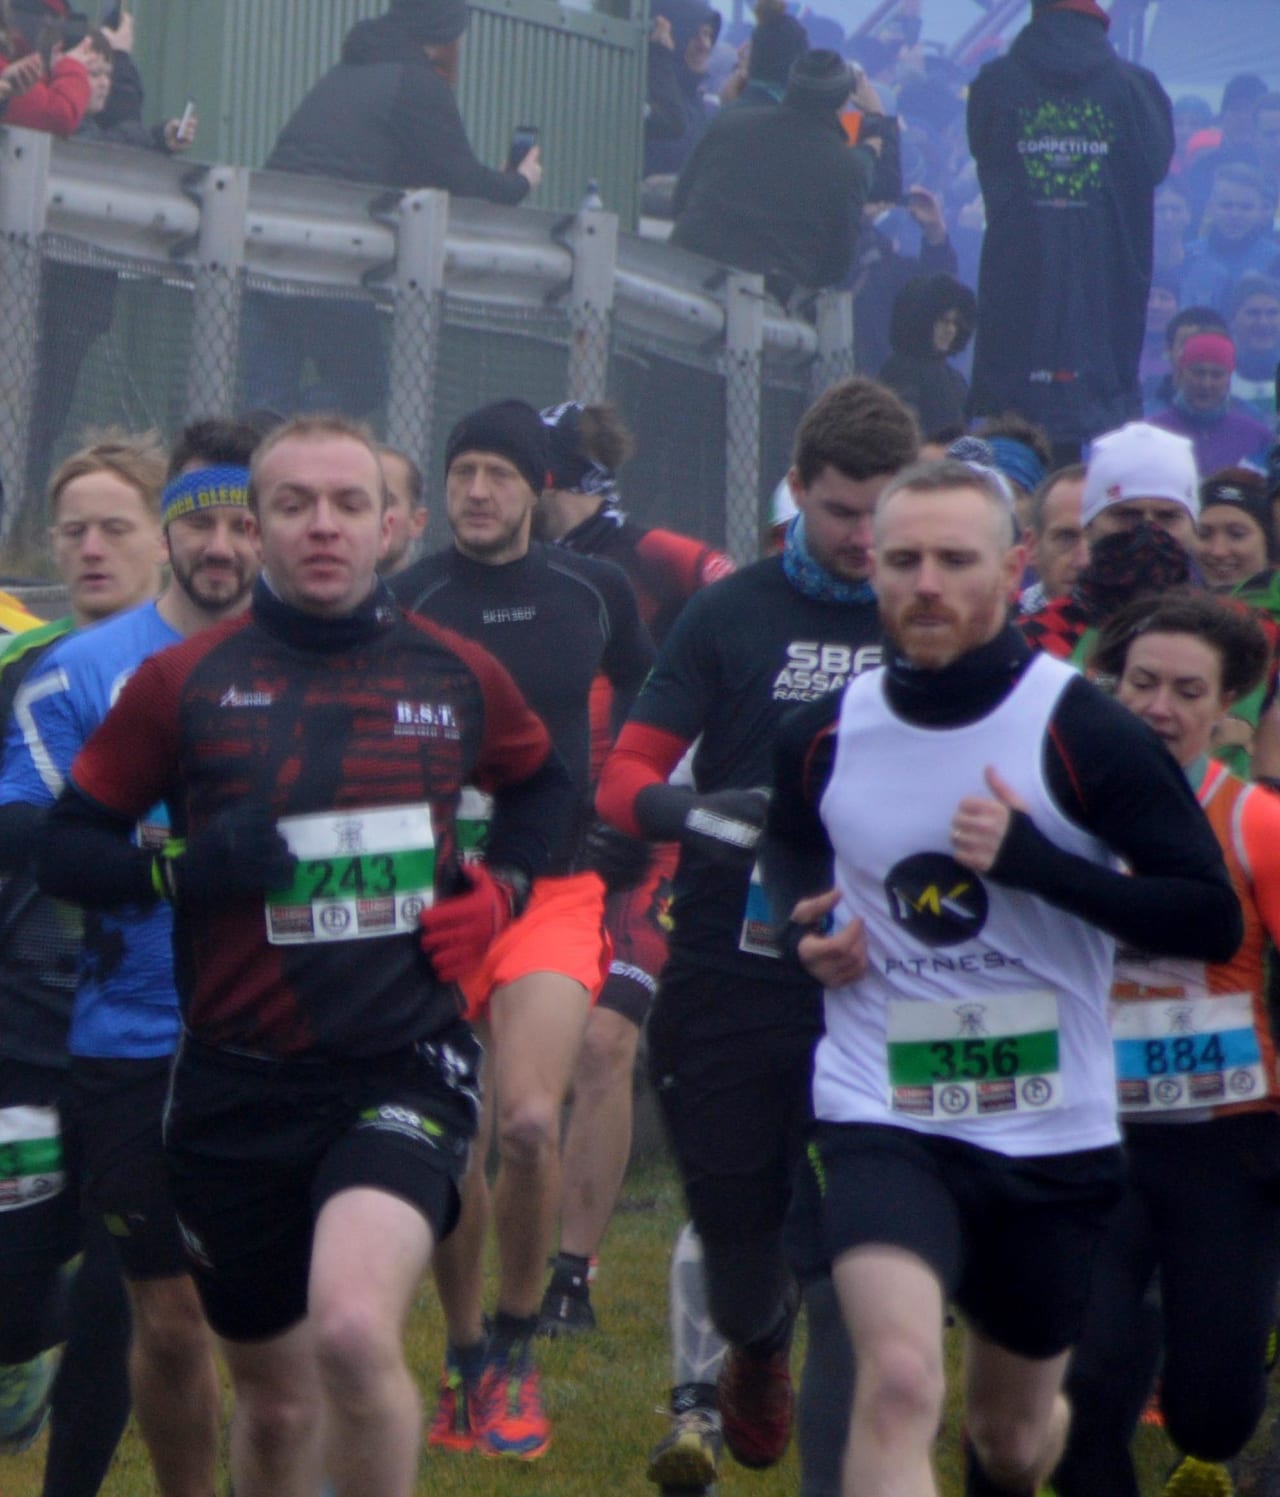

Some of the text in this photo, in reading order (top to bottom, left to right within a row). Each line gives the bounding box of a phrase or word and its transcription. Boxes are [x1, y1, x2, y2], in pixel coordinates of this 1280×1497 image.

[1017, 139, 1109, 155] COMPETITOR
[772, 666, 854, 692] ASSA
[305, 852, 398, 902] 243
[929, 1036, 1020, 1082] 356
[1144, 1032, 1226, 1075] 884
